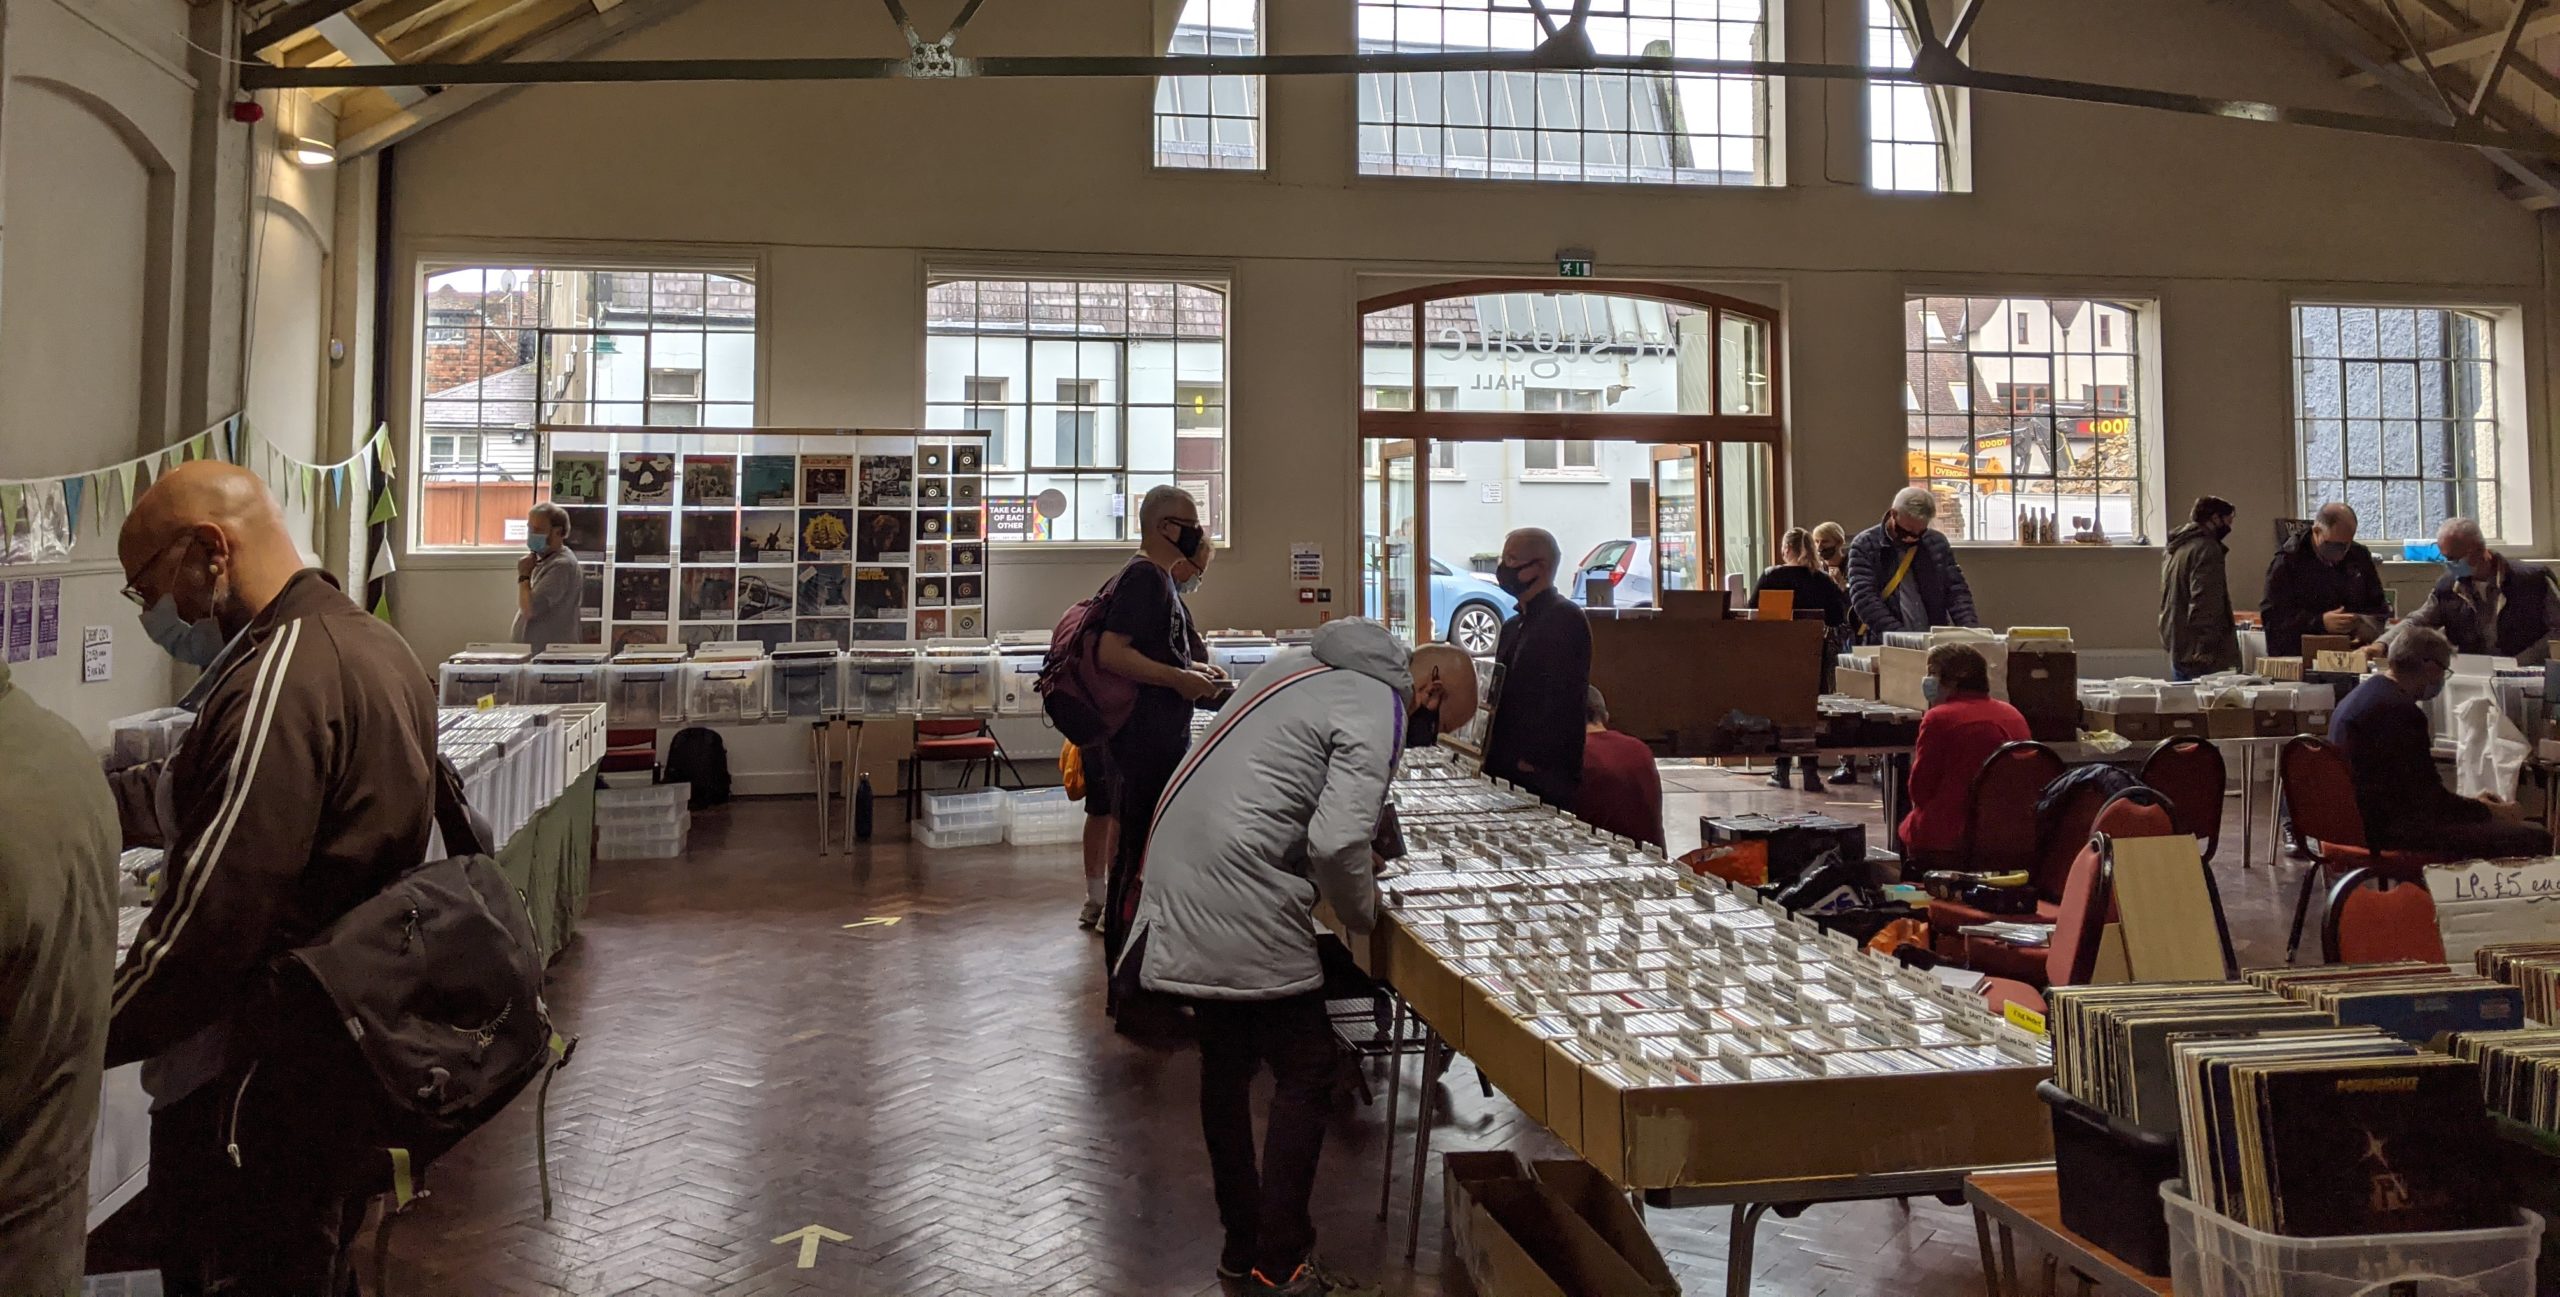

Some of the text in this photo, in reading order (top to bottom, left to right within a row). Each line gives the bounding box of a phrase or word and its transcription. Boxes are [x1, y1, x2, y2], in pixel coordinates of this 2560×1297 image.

[1979, 438, 2008, 449] GOODY
[997, 522, 1024, 530] OTHER
[2455, 872, 2488, 899] LPs
[2494, 871, 2522, 899] £5
